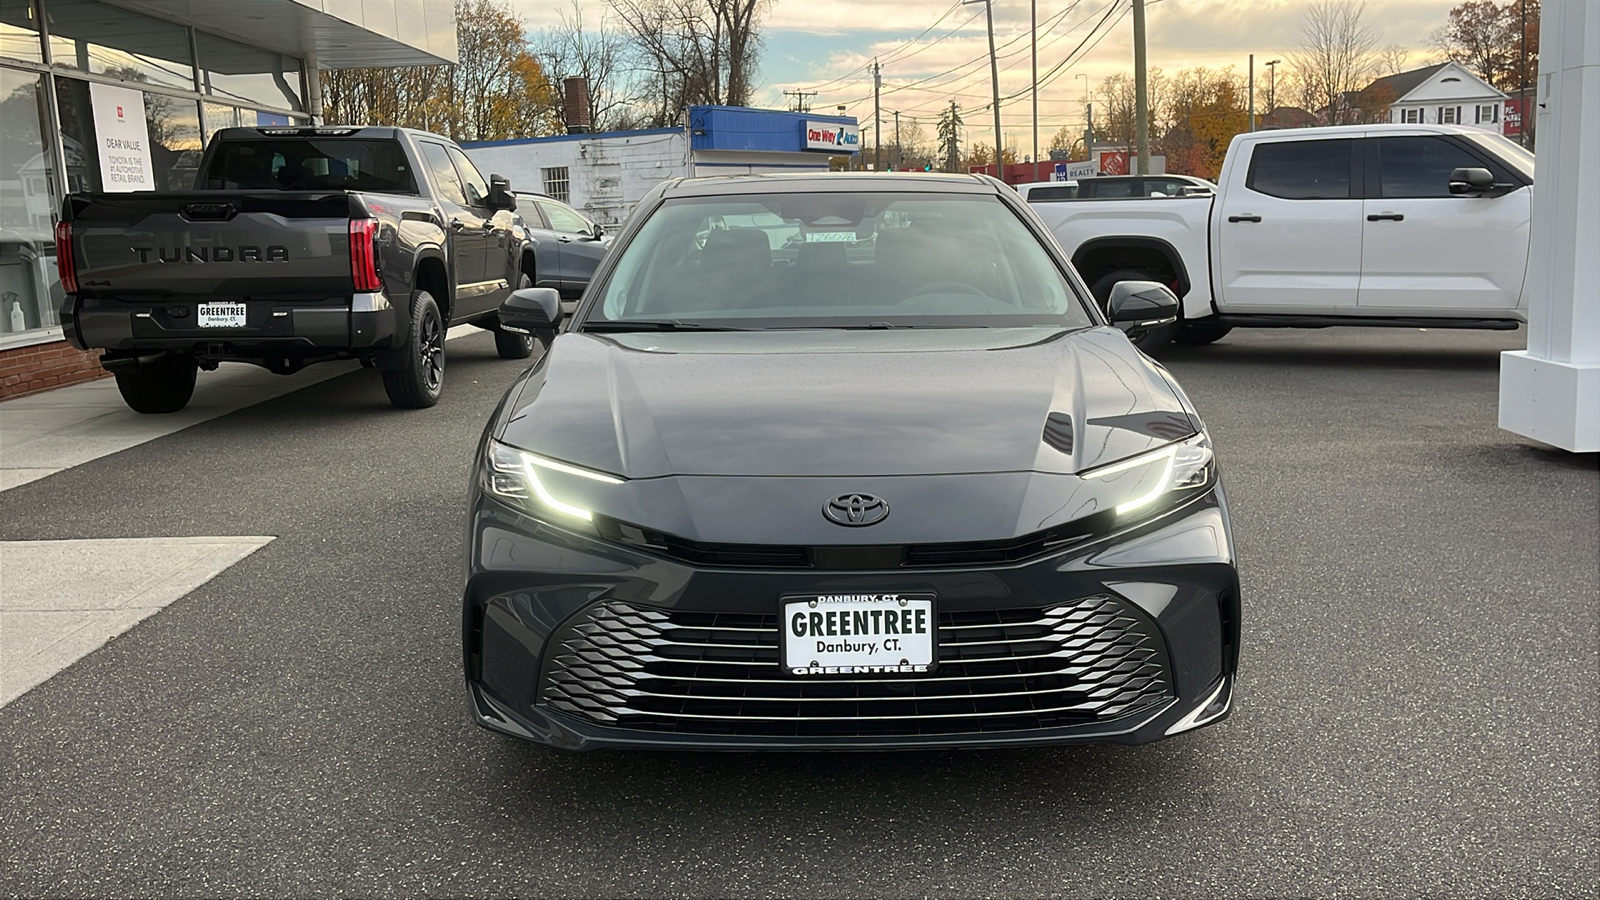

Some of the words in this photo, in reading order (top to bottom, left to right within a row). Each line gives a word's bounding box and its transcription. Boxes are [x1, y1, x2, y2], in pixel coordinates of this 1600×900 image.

[808, 129, 821, 141] One
[822, 130, 836, 145] Way
[843, 132, 858, 145] Auto
[106, 138, 122, 149] DEAR
[108, 156, 128, 165] TOYOTA
[133, 158, 143, 166] THE
[116, 166, 144, 175] AUTOMOTIVE
[1070, 168, 1095, 178] REALTY
[111, 173, 127, 183] RETAIL
[130, 245, 290, 263] TUNDRA
[200, 307, 245, 316] GREENTREE
[881, 594, 899, 602] CT
[791, 609, 927, 637] GREENTREE
[816, 639, 879, 655] Danbury,
[883, 639, 902, 651] CT.
[791, 665, 928, 676] GREENTREE
